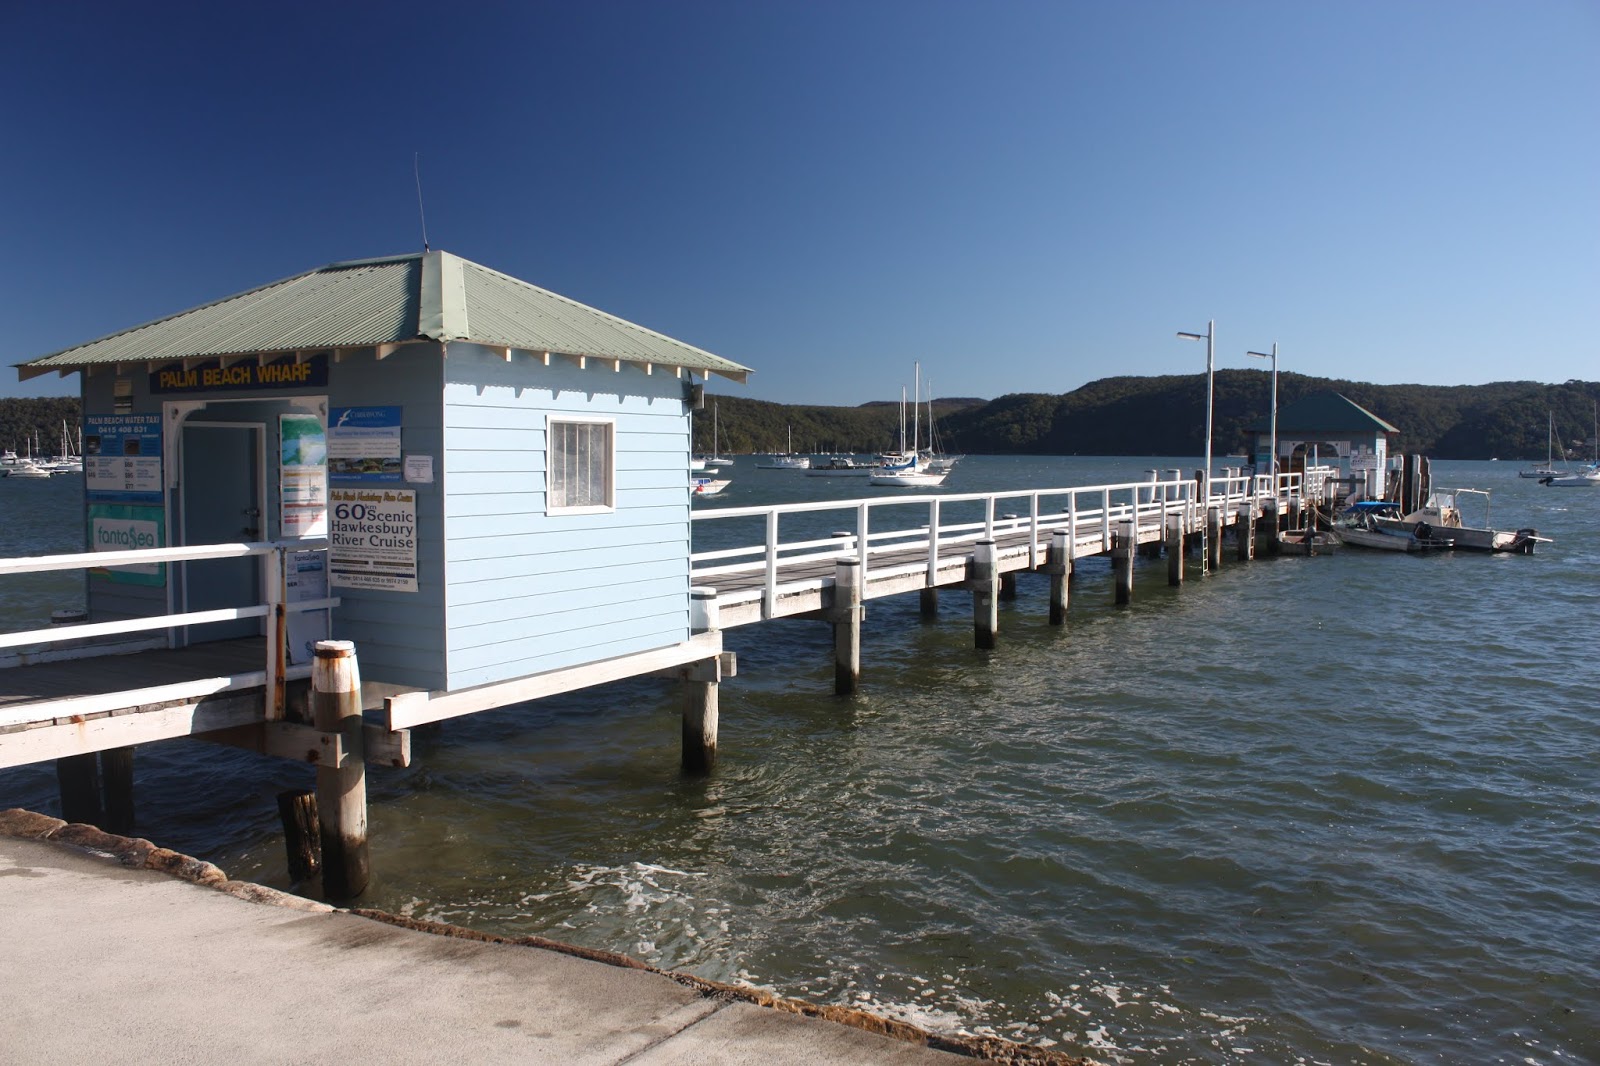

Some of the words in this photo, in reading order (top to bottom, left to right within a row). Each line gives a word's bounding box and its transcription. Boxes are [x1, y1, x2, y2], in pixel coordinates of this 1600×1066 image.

[160, 370, 197, 387] PALM
[203, 367, 250, 385] BEACH
[257, 363, 311, 382] WHARF
[88, 417, 102, 425] PALM
[104, 416, 123, 424] BEACH
[125, 416, 144, 424] WATER
[146, 415, 159, 424] TAXI
[335, 503, 366, 520] 60
[367, 509, 413, 523] Scenic
[331, 520, 414, 537] Hawkesbury
[332, 533, 364, 546] River
[369, 534, 414, 548] Cruise
